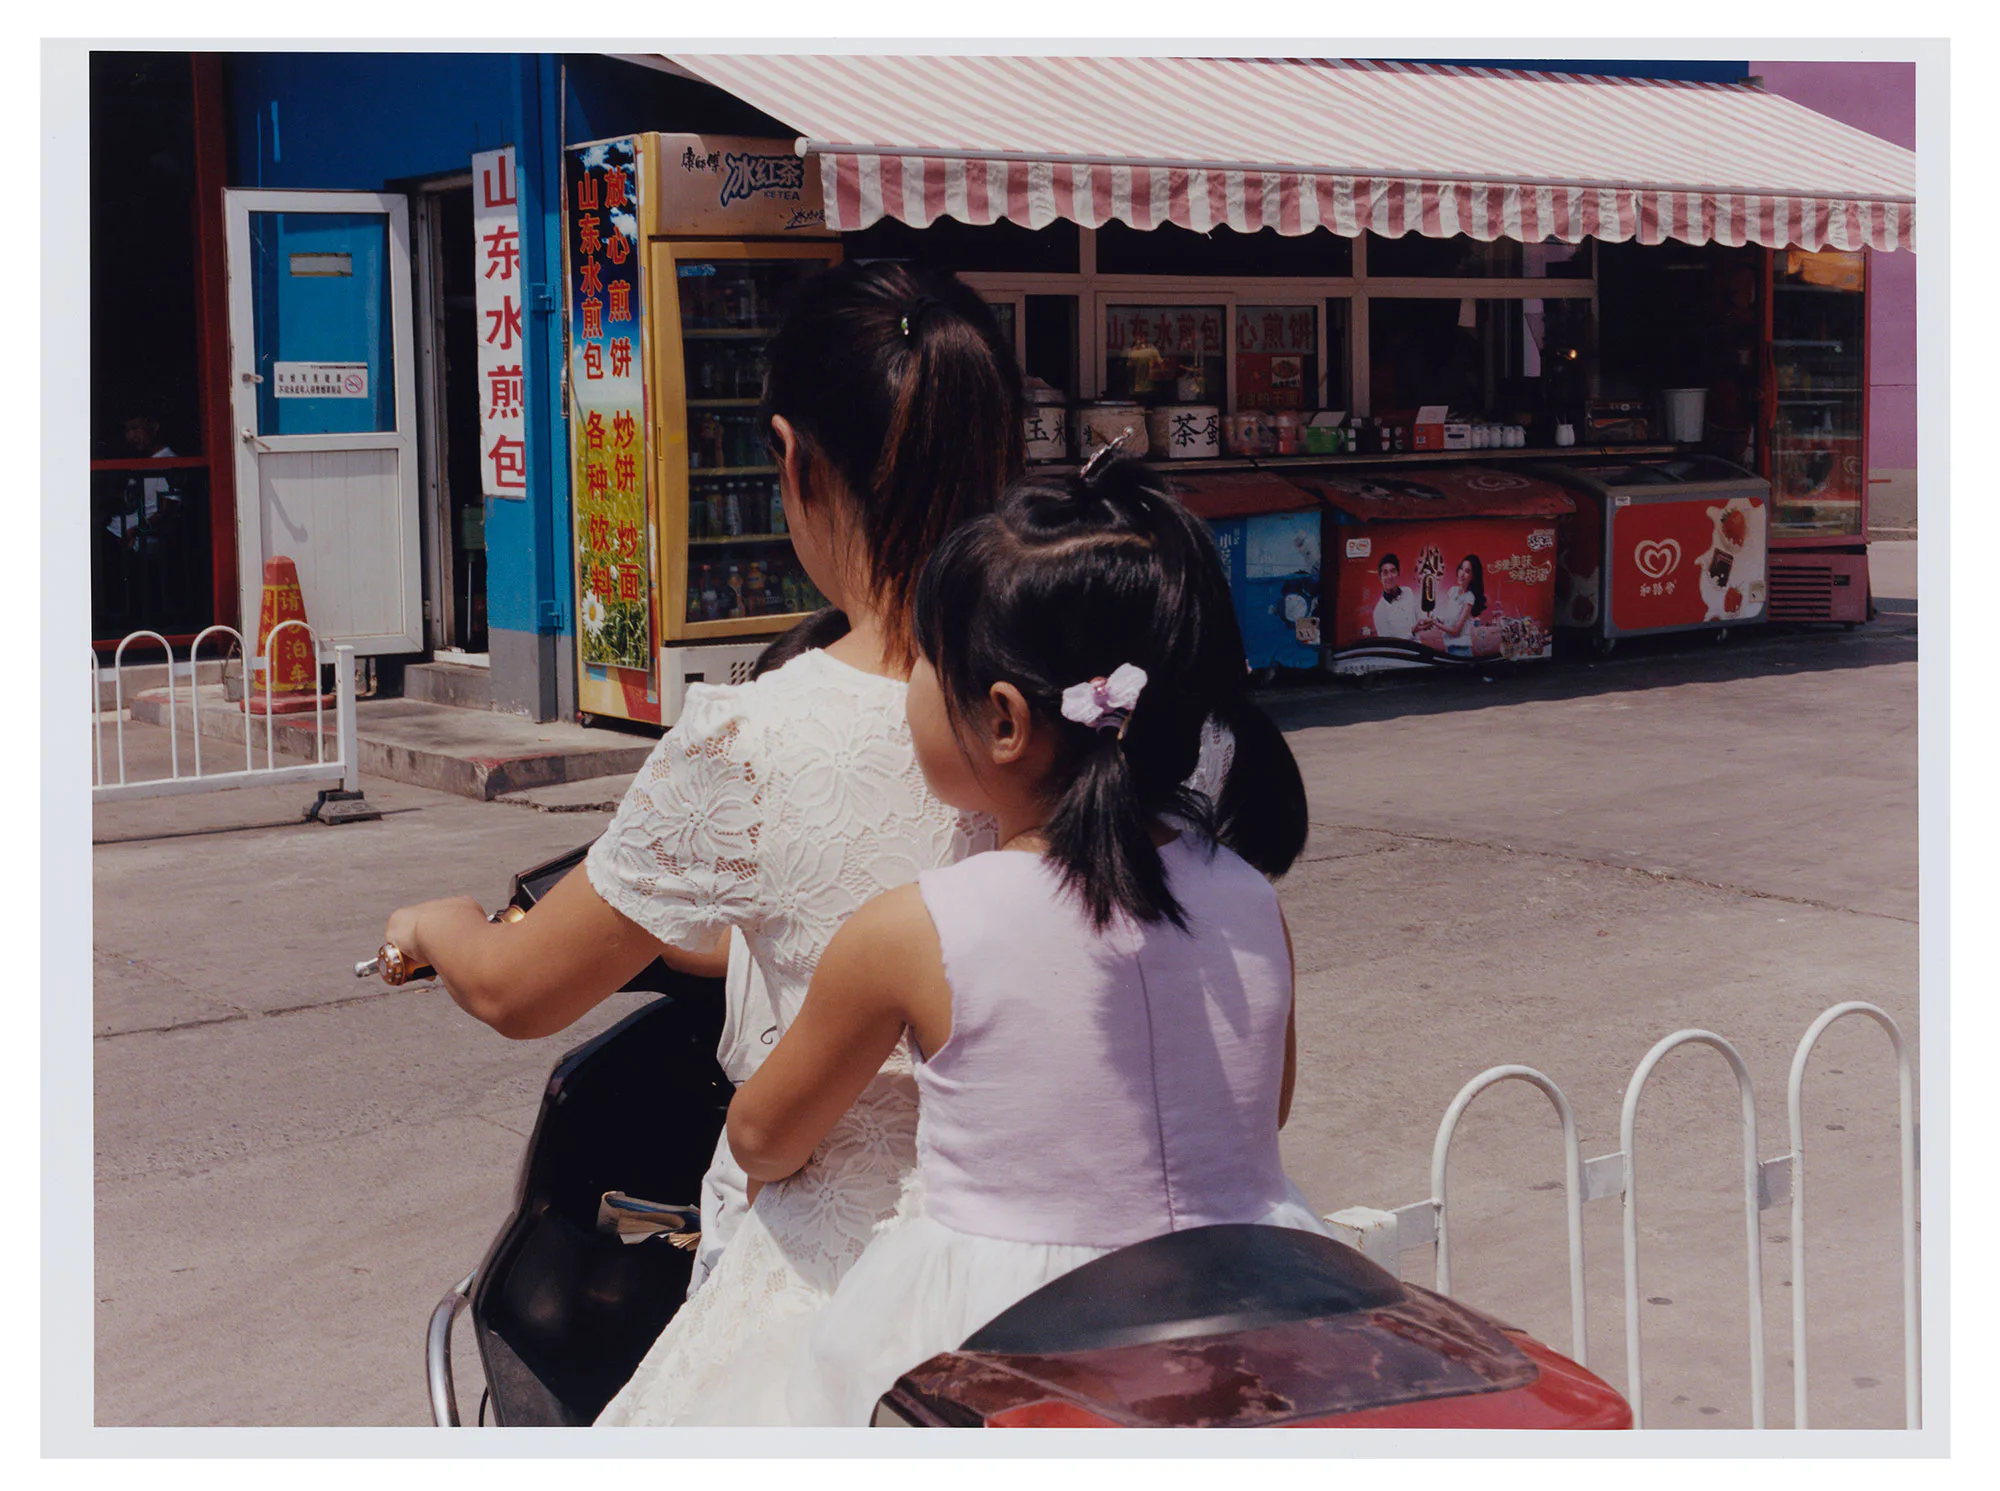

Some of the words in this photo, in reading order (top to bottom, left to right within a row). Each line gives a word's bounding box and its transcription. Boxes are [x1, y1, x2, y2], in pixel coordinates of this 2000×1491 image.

[720, 152, 804, 207] 冰红茶
[483, 155, 526, 488] 山东水煎包
[578, 171, 603, 380] 山东水煎包
[604, 165, 632, 379] 放心煎饼
[1106, 312, 1219, 350] 山东水煎包
[586, 410, 612, 604] 各种饮料
[613, 409, 635, 493] 炒饼
[616, 519, 639, 602] 炒面
